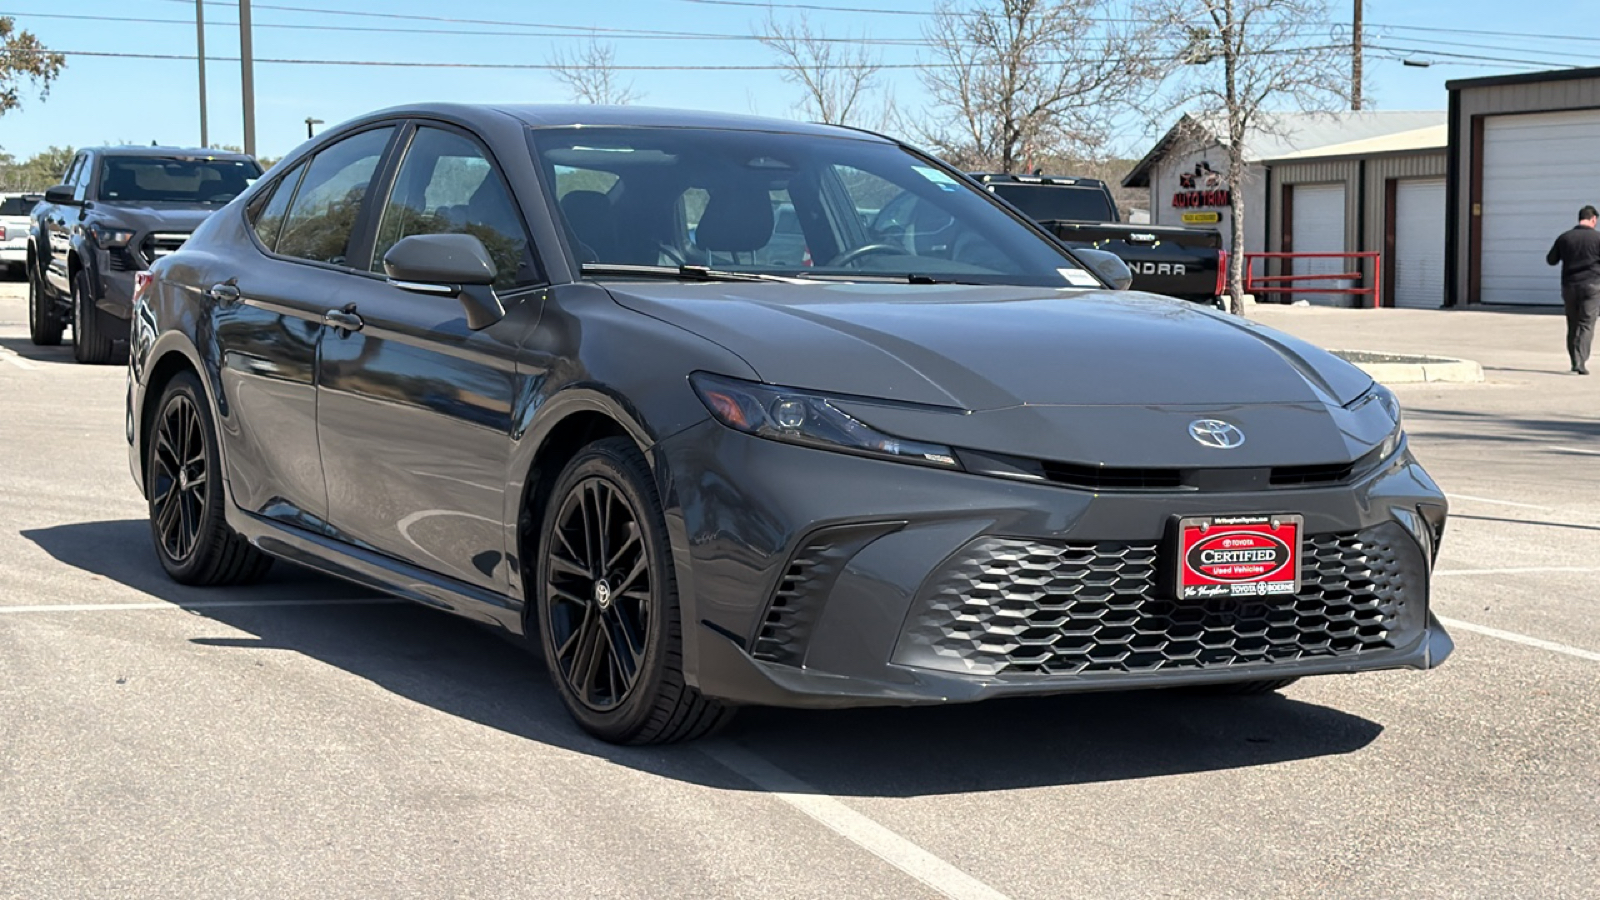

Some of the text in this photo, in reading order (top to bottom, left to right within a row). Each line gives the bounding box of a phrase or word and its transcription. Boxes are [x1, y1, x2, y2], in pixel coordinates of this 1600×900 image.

[1172, 191, 1227, 208] AUTO TRIM
[1129, 262, 1186, 276] NDRA
[1213, 566, 1232, 575] Used
[1231, 585, 1257, 594] TOYOTA
